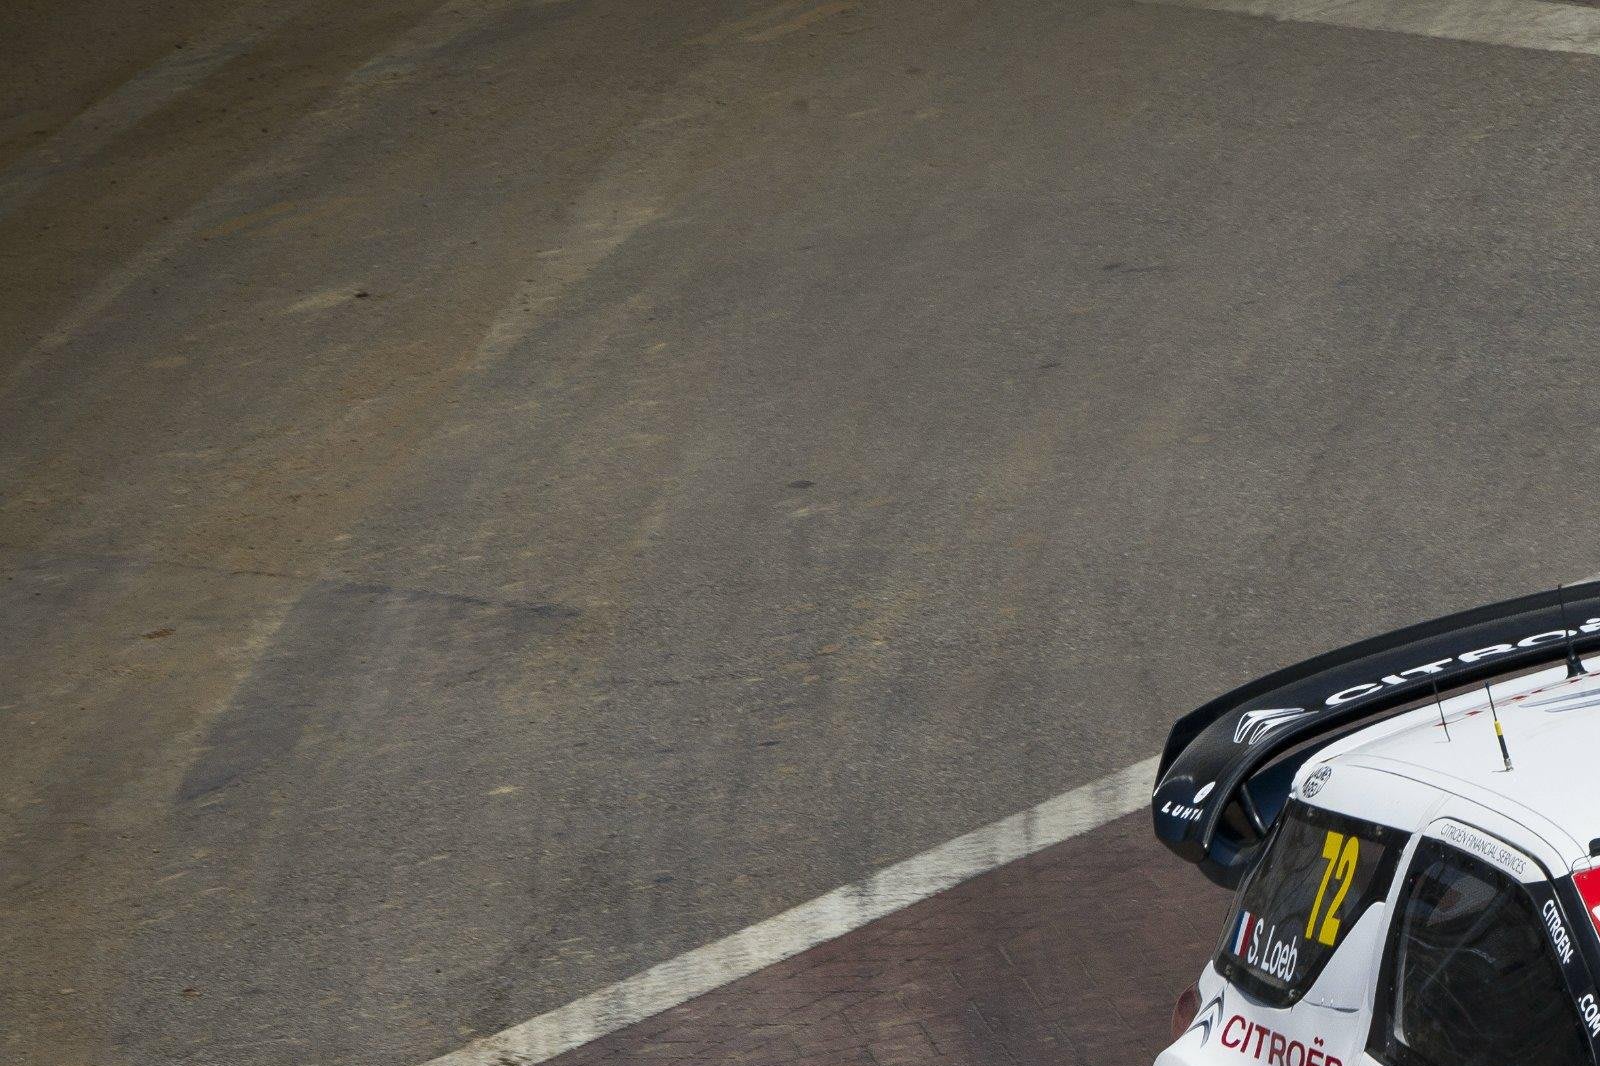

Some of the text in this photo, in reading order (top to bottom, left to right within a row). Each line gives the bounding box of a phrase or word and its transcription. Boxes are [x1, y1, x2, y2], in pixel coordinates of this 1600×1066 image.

[1465, 834, 1498, 859] FINANCIAL
[1496, 849, 1527, 875] SERVICES
[1304, 830, 1360, 947] 72
[1247, 917, 1298, 982] S. Loeb
